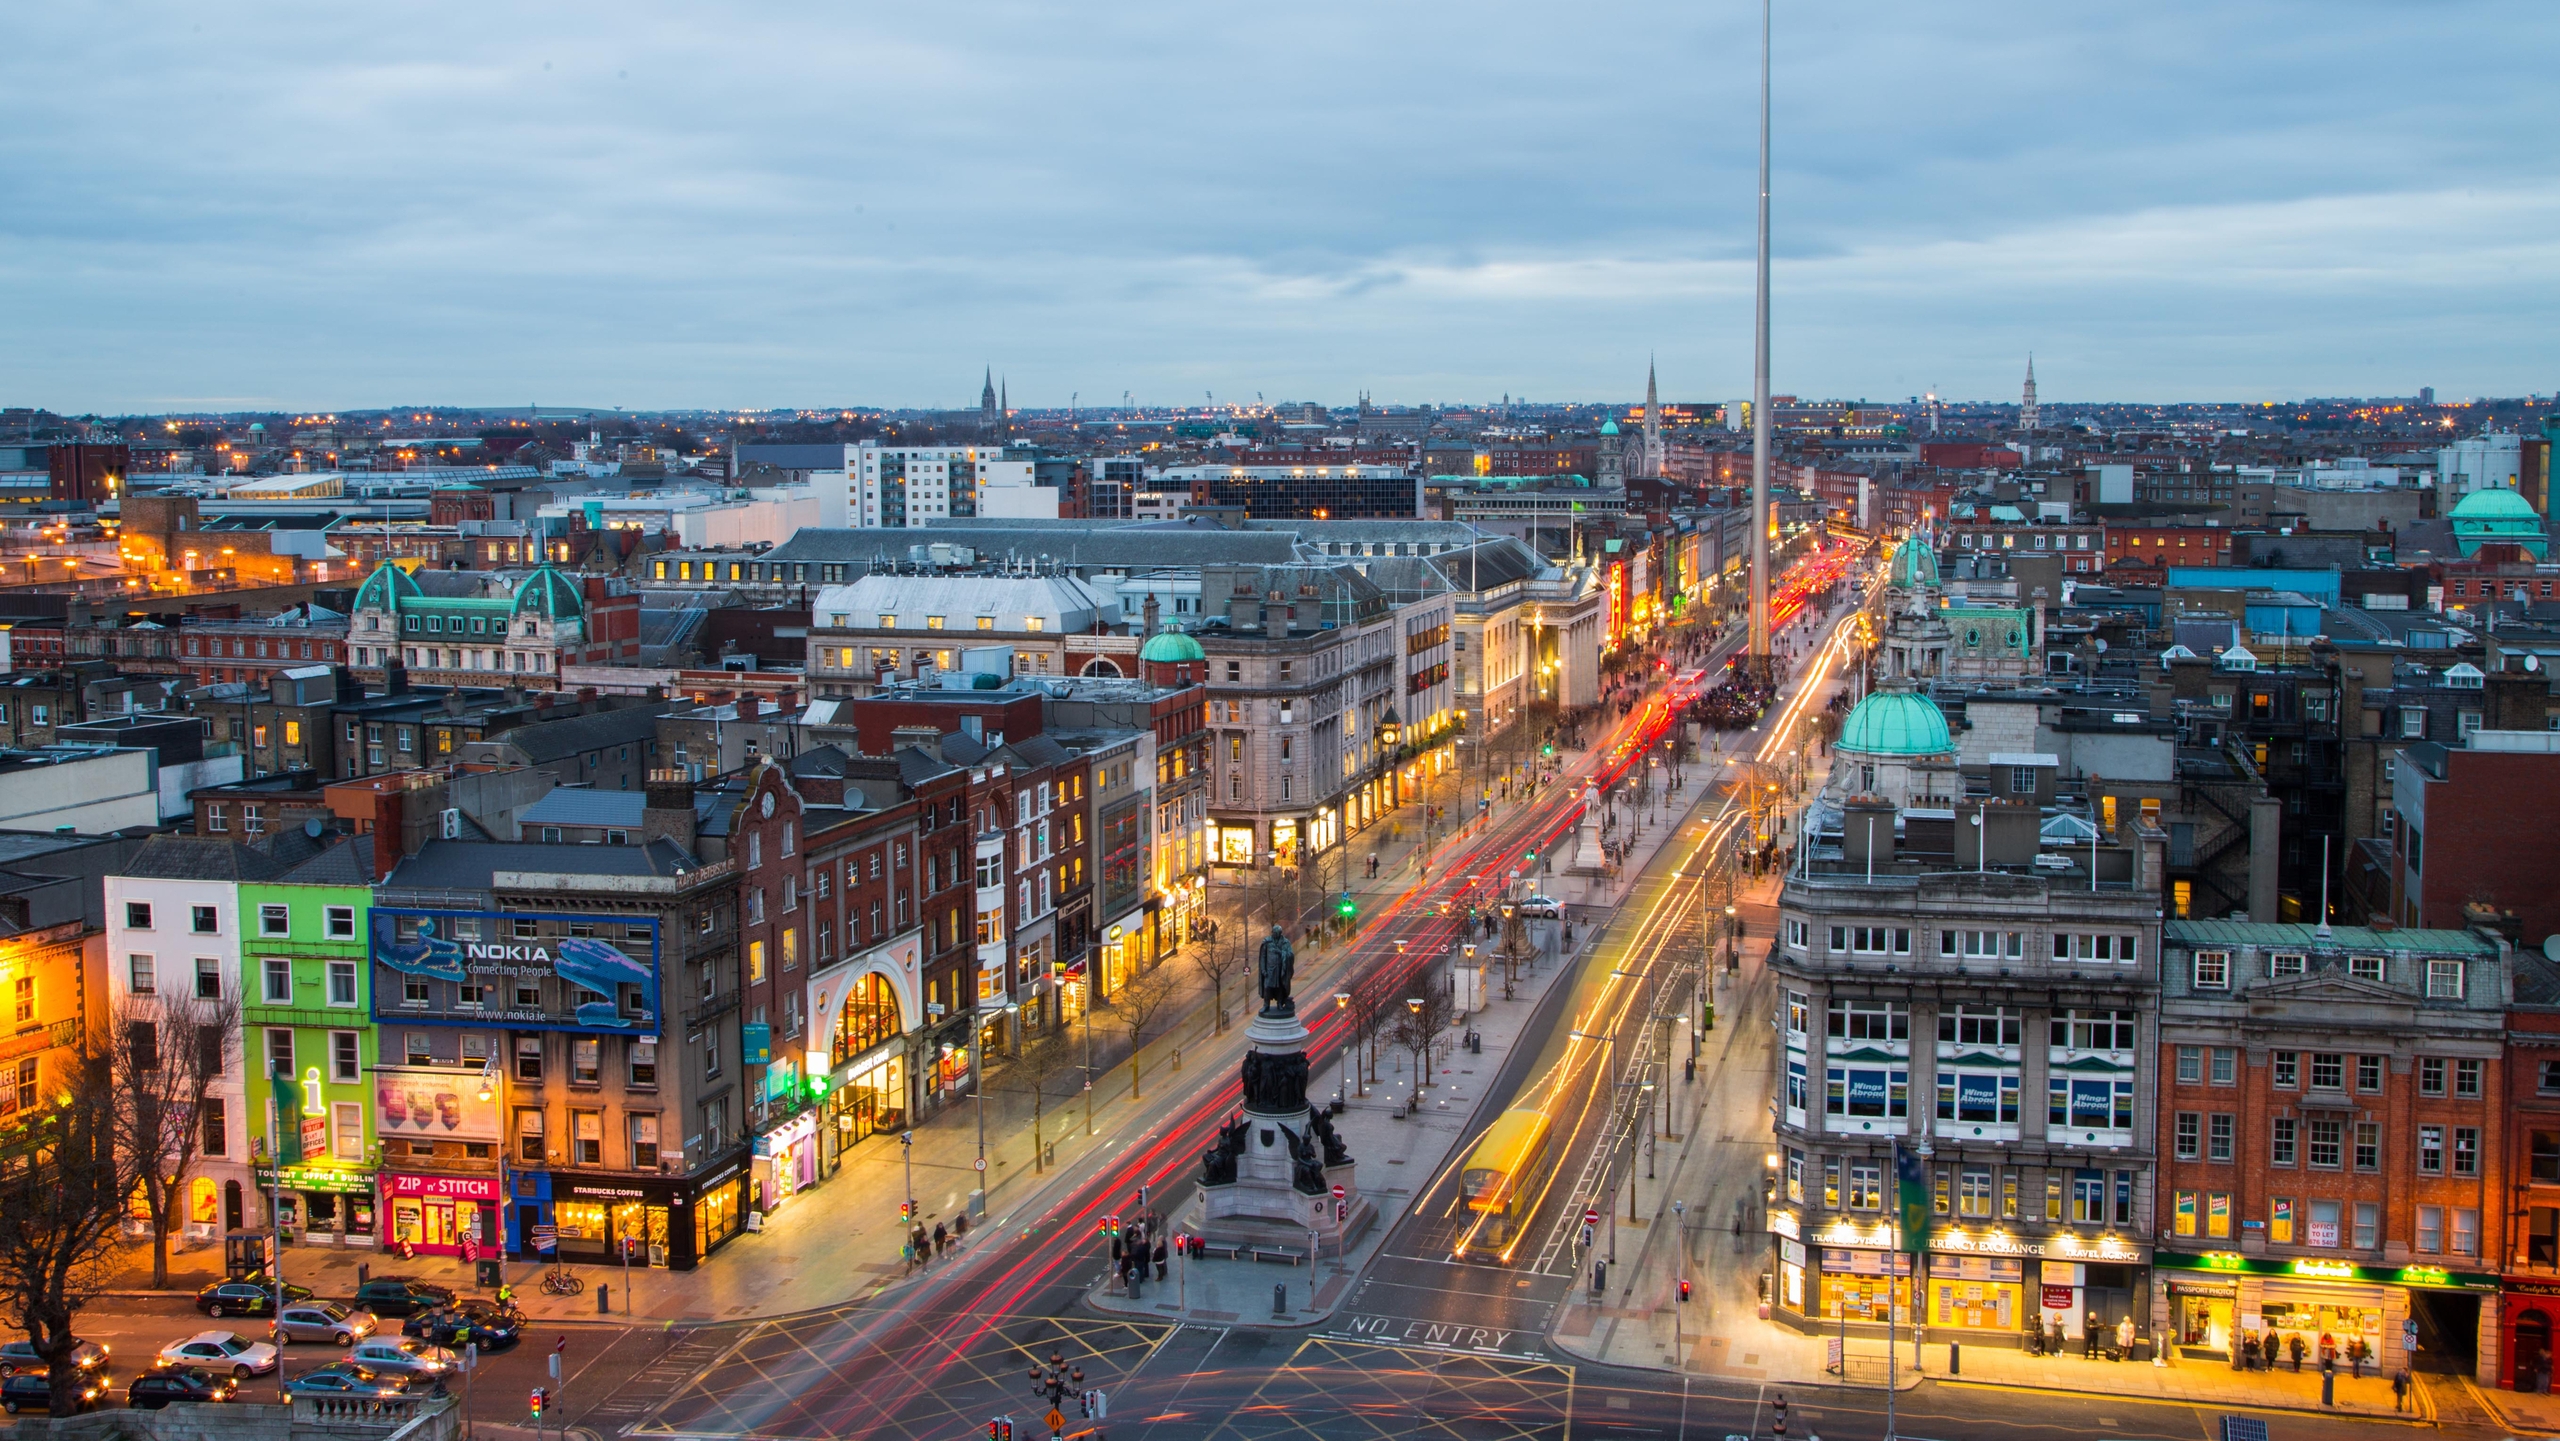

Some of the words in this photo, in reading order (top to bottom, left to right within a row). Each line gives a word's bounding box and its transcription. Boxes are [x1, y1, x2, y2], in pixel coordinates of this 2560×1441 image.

[700, 861, 727, 880] PETERSON
[468, 944, 550, 961] NOKIA
[468, 963, 518, 977] Connecting
[520, 966, 552, 978] People
[476, 1010, 546, 1022] www.nokia.ie
[848, 1057, 873, 1081] BURGER
[873, 1048, 889, 1067] KING
[1853, 1082, 1883, 1090] Wings
[1850, 1088, 1885, 1097] Abroad
[1964, 1088, 1994, 1097] Wings
[2077, 1093, 2107, 1102] Wings
[1960, 1095, 1997, 1104] Abroad
[2072, 1100, 2109, 1109] Abroad
[303, 1138, 325, 1149] OFFICES
[257, 1170, 296, 1179] TOURIST
[303, 1171, 335, 1181] OFFICE
[341, 1174, 374, 1183] DUBLIN
[702, 1172, 724, 1190] STARBUCKS
[724, 1163, 738, 1176] COFFEE
[398, 1177, 421, 1190] ZIP
[439, 1179, 488, 1194] STITCH
[573, 1186, 616, 1196] STARBUCKS
[616, 1188, 644, 1197] COFFEE
[2277, 1203, 2287, 1211] ID
[1979, 1241, 2046, 1256] EXCHANGE
[2065, 1248, 2099, 1259] TRAVEL
[2101, 1250, 2141, 1262] AGENCY
[2403, 1274, 2423, 1282] Eden
[2424, 1274, 2446, 1285] Quay
[2176, 1285, 2208, 1294] PASSPORT
[2209, 1287, 2235, 1296] PHOTOS
[2517, 1284, 2549, 1295] Carlyle
[1347, 1316, 1390, 1334] NO
[1404, 1322, 1511, 1347] ENTRY
